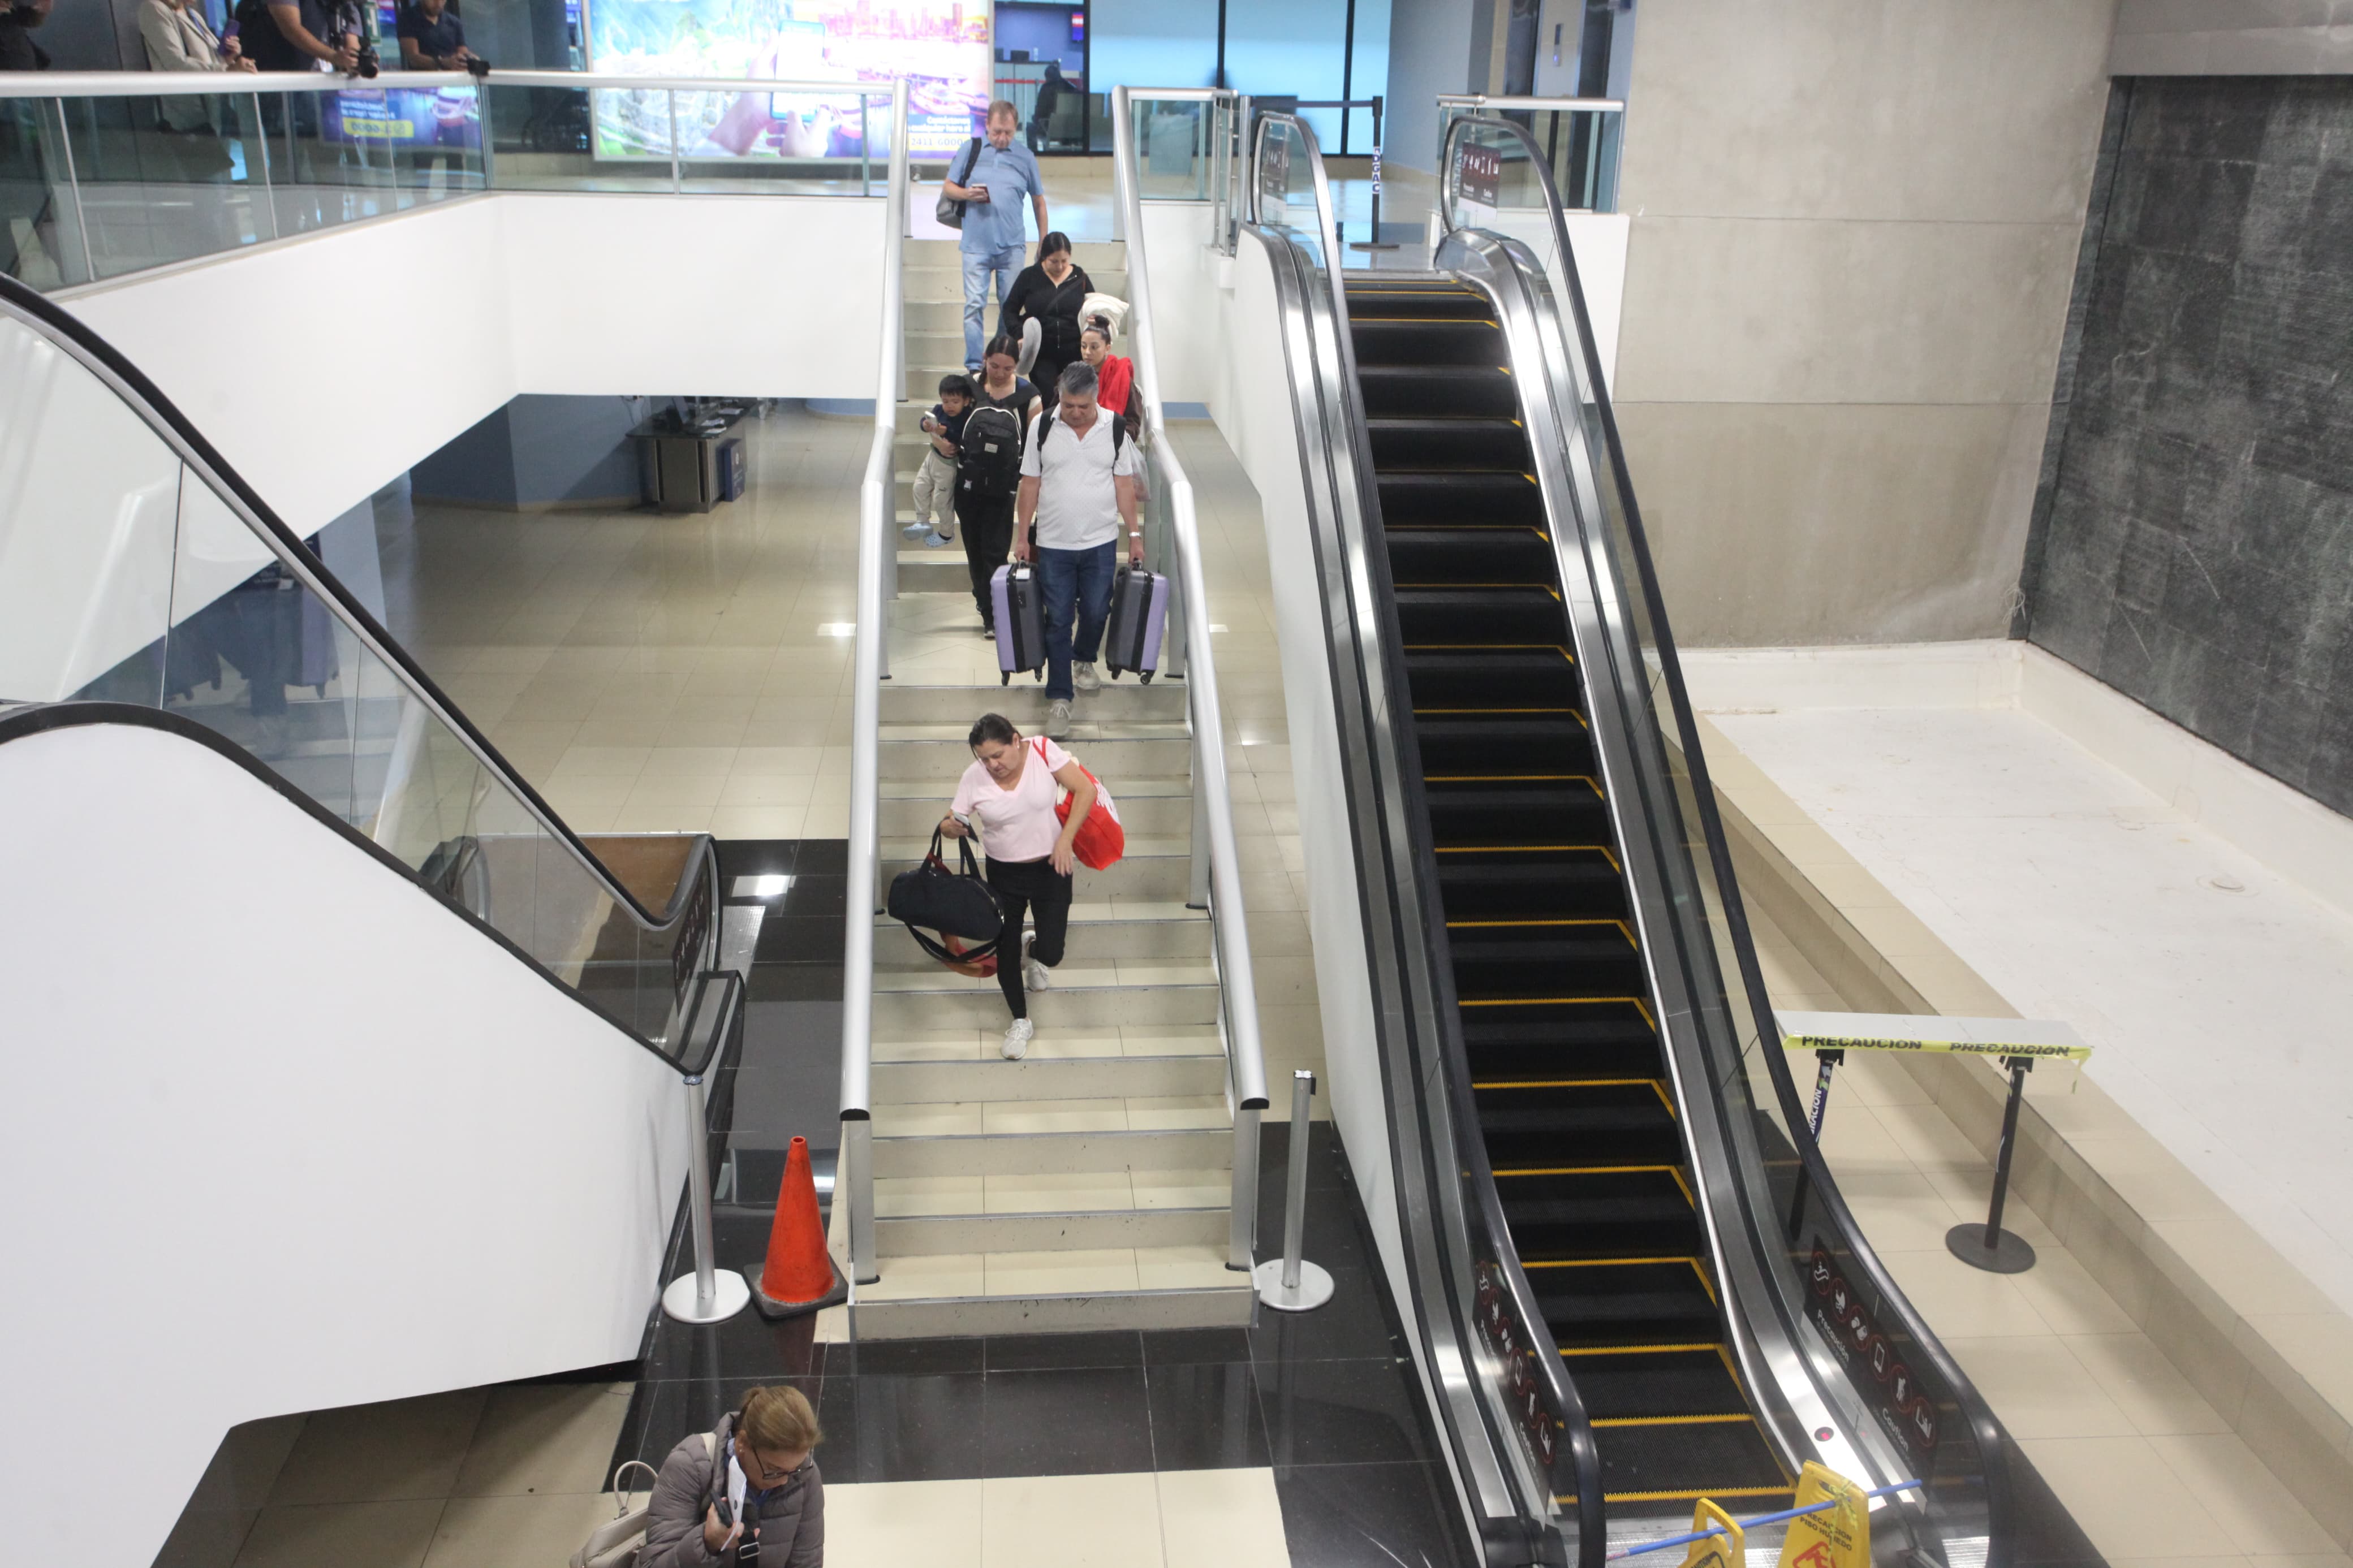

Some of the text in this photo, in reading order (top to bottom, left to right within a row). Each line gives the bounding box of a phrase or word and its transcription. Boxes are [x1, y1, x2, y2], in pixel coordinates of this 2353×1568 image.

[911, 137, 933, 146] 2411
[1372, 154, 1381, 193] DGAC
[1817, 1308, 1849, 1362] Precaución
[1882, 1407, 1908, 1453] Caution
[1800, 1516, 1818, 1531] PISO
